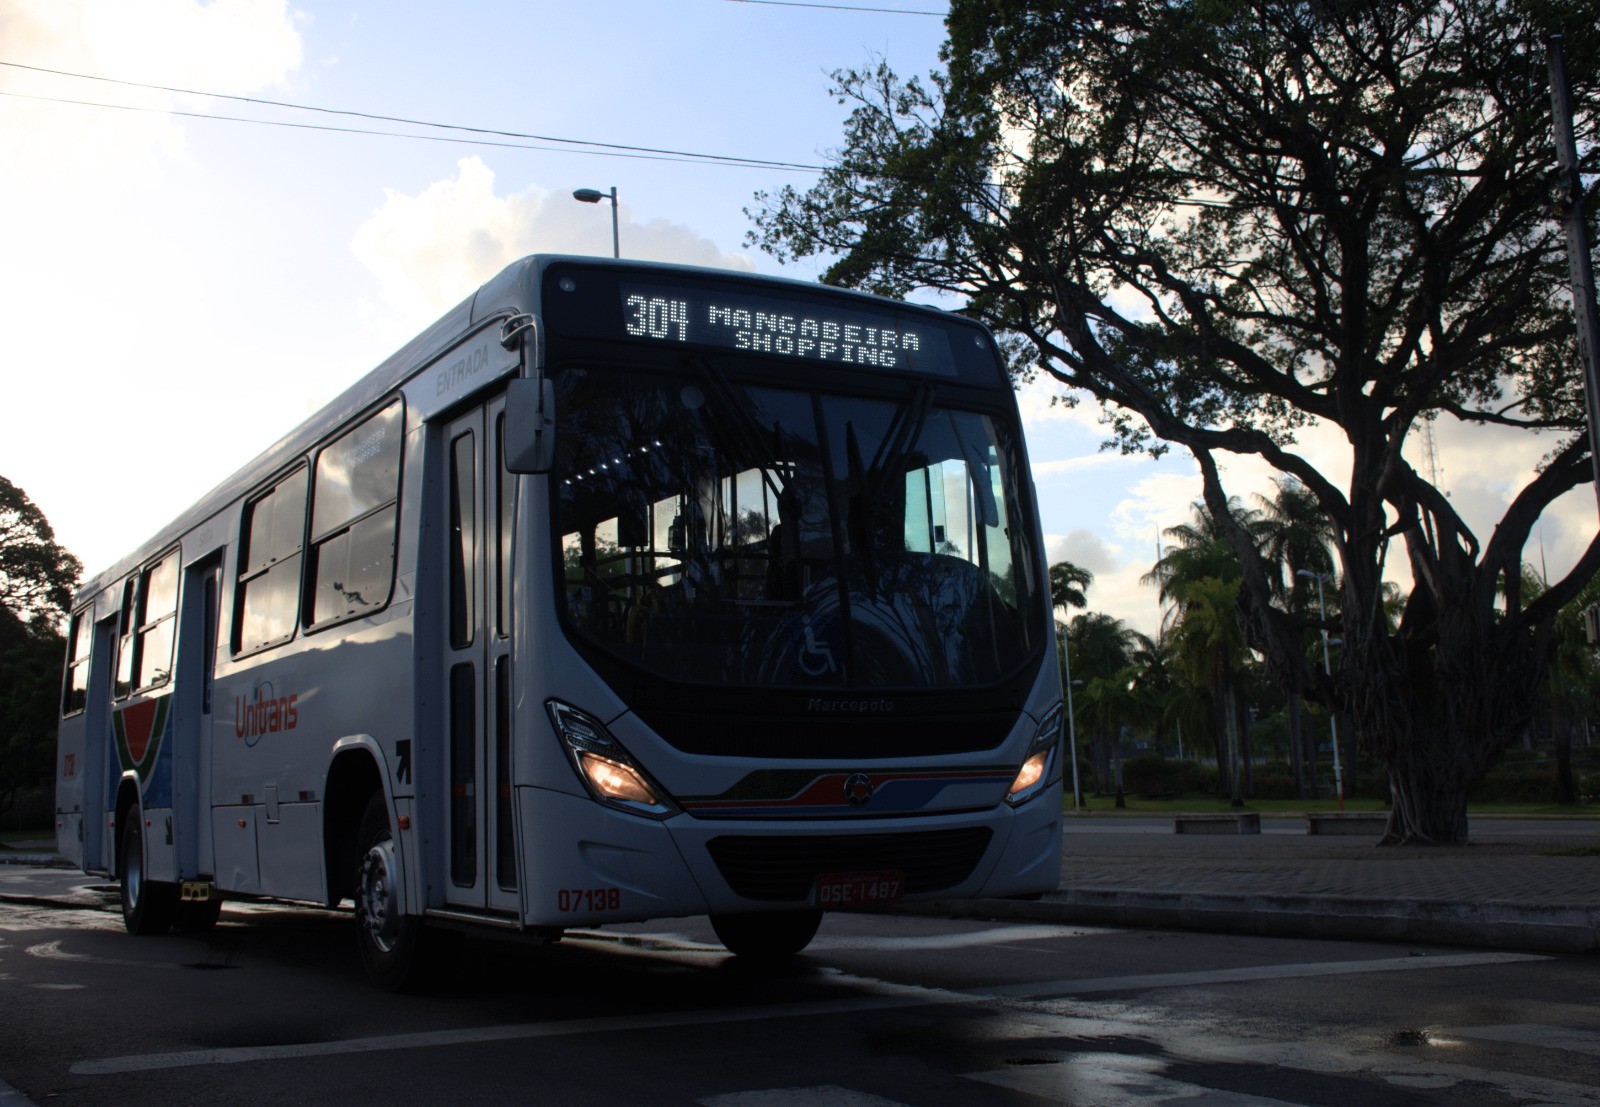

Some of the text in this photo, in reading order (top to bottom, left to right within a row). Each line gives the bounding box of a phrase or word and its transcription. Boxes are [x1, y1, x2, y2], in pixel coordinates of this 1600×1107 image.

[626, 294, 689, 341] 304
[708, 305, 919, 351] MANGABEIRA
[436, 344, 489, 397] ENTRADA
[735, 330, 896, 367] SHOPPING
[235, 686, 298, 738] Unitrans
[558, 887, 620, 912] 07138
